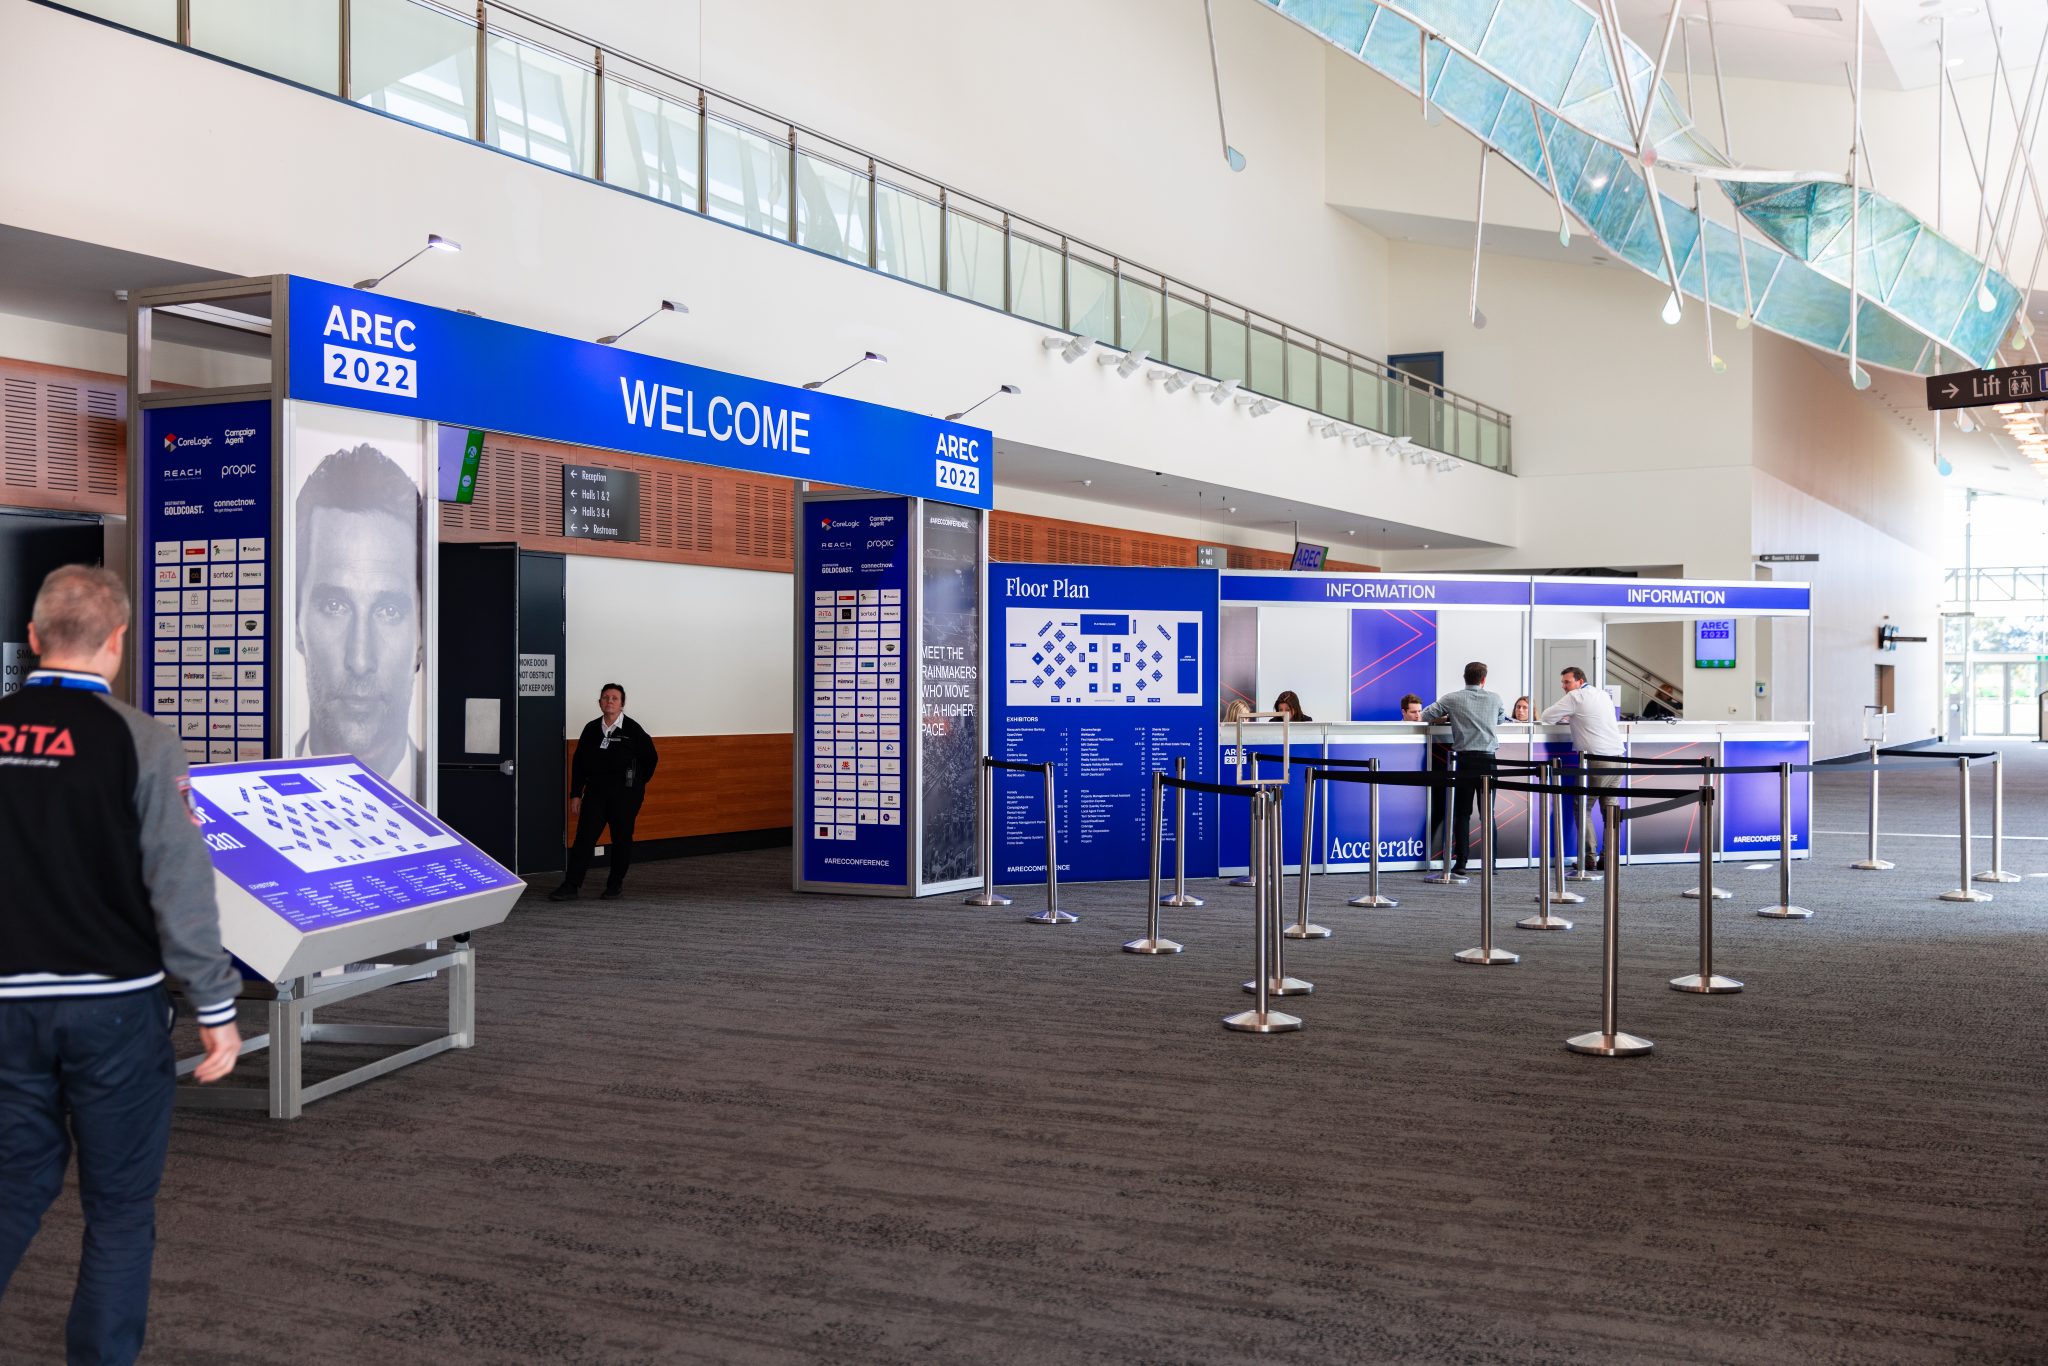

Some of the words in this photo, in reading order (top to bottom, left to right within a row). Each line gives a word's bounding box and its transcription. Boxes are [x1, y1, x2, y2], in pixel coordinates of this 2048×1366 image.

[324, 305, 416, 352] AREC
[333, 353, 409, 390] 2022
[1973, 375, 2000, 397] Lift
[620, 377, 810, 455] WELCOME
[225, 428, 256, 437] Campaign
[178, 437, 212, 447] CoreLogic
[225, 437, 244, 446] Agent
[936, 433, 979, 463] AREC
[164, 468, 202, 477] REACH
[222, 464, 256, 478] propic
[582, 470, 606, 483] Reception
[940, 465, 976, 489] 2022
[582, 490, 595, 499] Halls
[601, 492, 605, 500] &
[607, 492, 610, 501] 2
[214, 499, 256, 507] connectnow.
[164, 505, 204, 516] GOLDCOAST.
[582, 507, 595, 516] Halls
[597, 508, 600, 517] 3
[602, 508, 605, 518] &
[607, 508, 610, 518] 4
[594, 524, 617, 535] Restrooms
[832, 520, 859, 528] CoreLogic
[867, 540, 894, 549] propic
[1295, 549, 1320, 567] AREC
[1006, 577, 1048, 596] Floor
[1053, 579, 1089, 598] Plan
[1326, 583, 1435, 599] INFORMATION
[1628, 588, 1725, 604] INFORMATION
[922, 646, 945, 659] MEET
[947, 647, 964, 659] THE
[6, 666, 18, 675] DO
[922, 666, 976, 678] RAINMAKERS
[5, 683, 17, 692] DO
[922, 685, 942, 697] WHO
[945, 685, 969, 697] MOVE
[922, 704, 932, 716] AT
[934, 704, 939, 716] A
[942, 704, 974, 716] HIGHER
[922, 723, 946, 735] PACE.
[0, 724, 75, 756] RiTA
[202, 832, 246, 851] lan
[1734, 834, 1798, 843] #ARECCONFERCE
[1330, 837, 1424, 858] Acceerate
[824, 858, 890, 866] #ARECCONFERENCE
